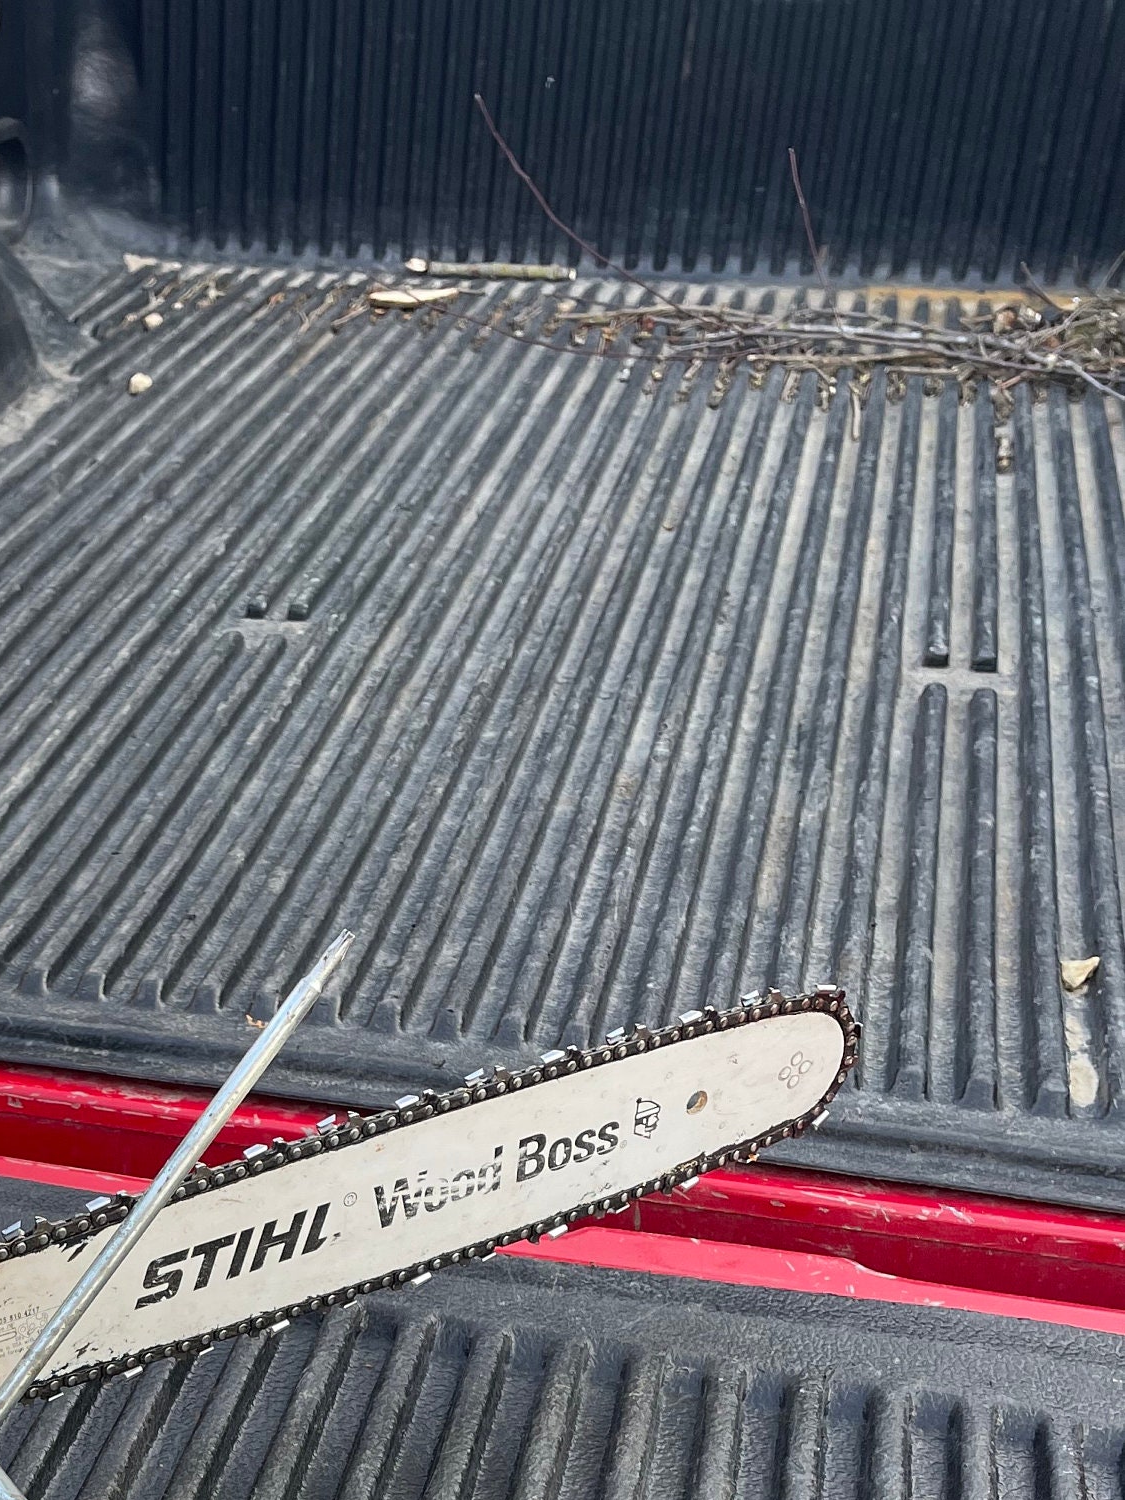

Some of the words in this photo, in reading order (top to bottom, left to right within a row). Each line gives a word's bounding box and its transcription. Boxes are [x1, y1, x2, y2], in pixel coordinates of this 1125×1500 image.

[374, 1145, 503, 1228] Wood
[516, 1121, 620, 1183] Boss
[135, 1202, 331, 1310] STIHL
